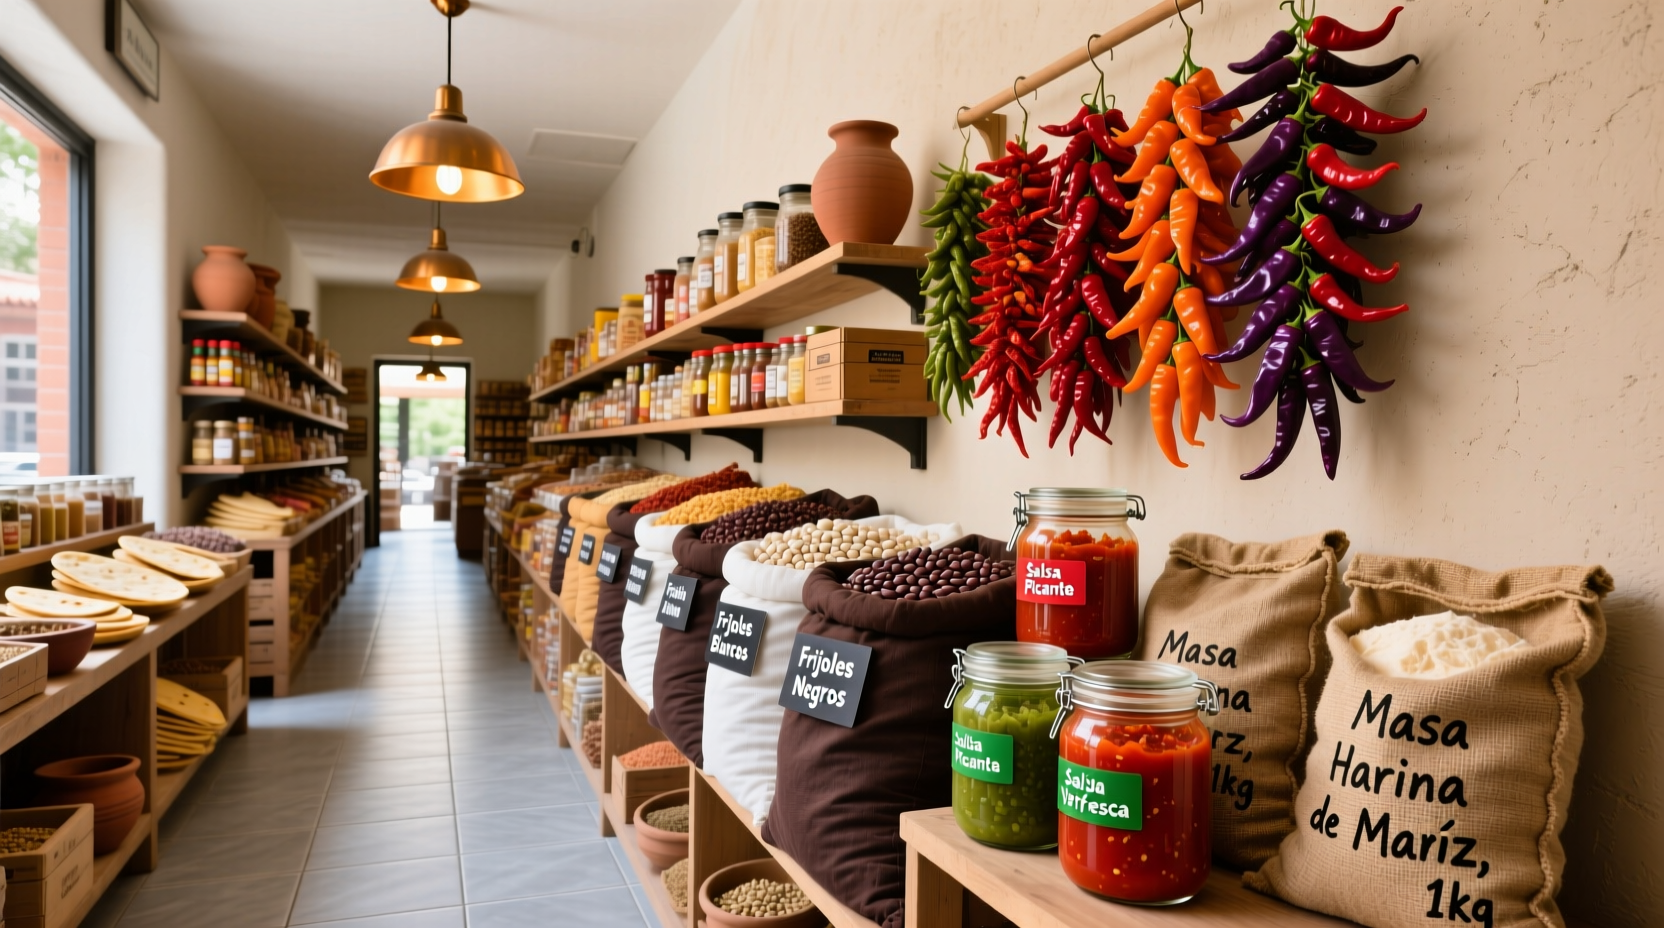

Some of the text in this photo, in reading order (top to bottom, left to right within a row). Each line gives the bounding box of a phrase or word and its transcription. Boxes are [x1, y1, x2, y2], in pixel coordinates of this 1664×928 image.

[1026, 561, 1062, 580] Salsa
[798, 645, 855, 678] Frijoles
[1157, 629, 1238, 669] Masa
[792, 674, 847, 709] Negros
[1351, 689, 1469, 750] Masa
[1330, 741, 1468, 808] Harina
[1310, 794, 1490, 878] de Maríz,
